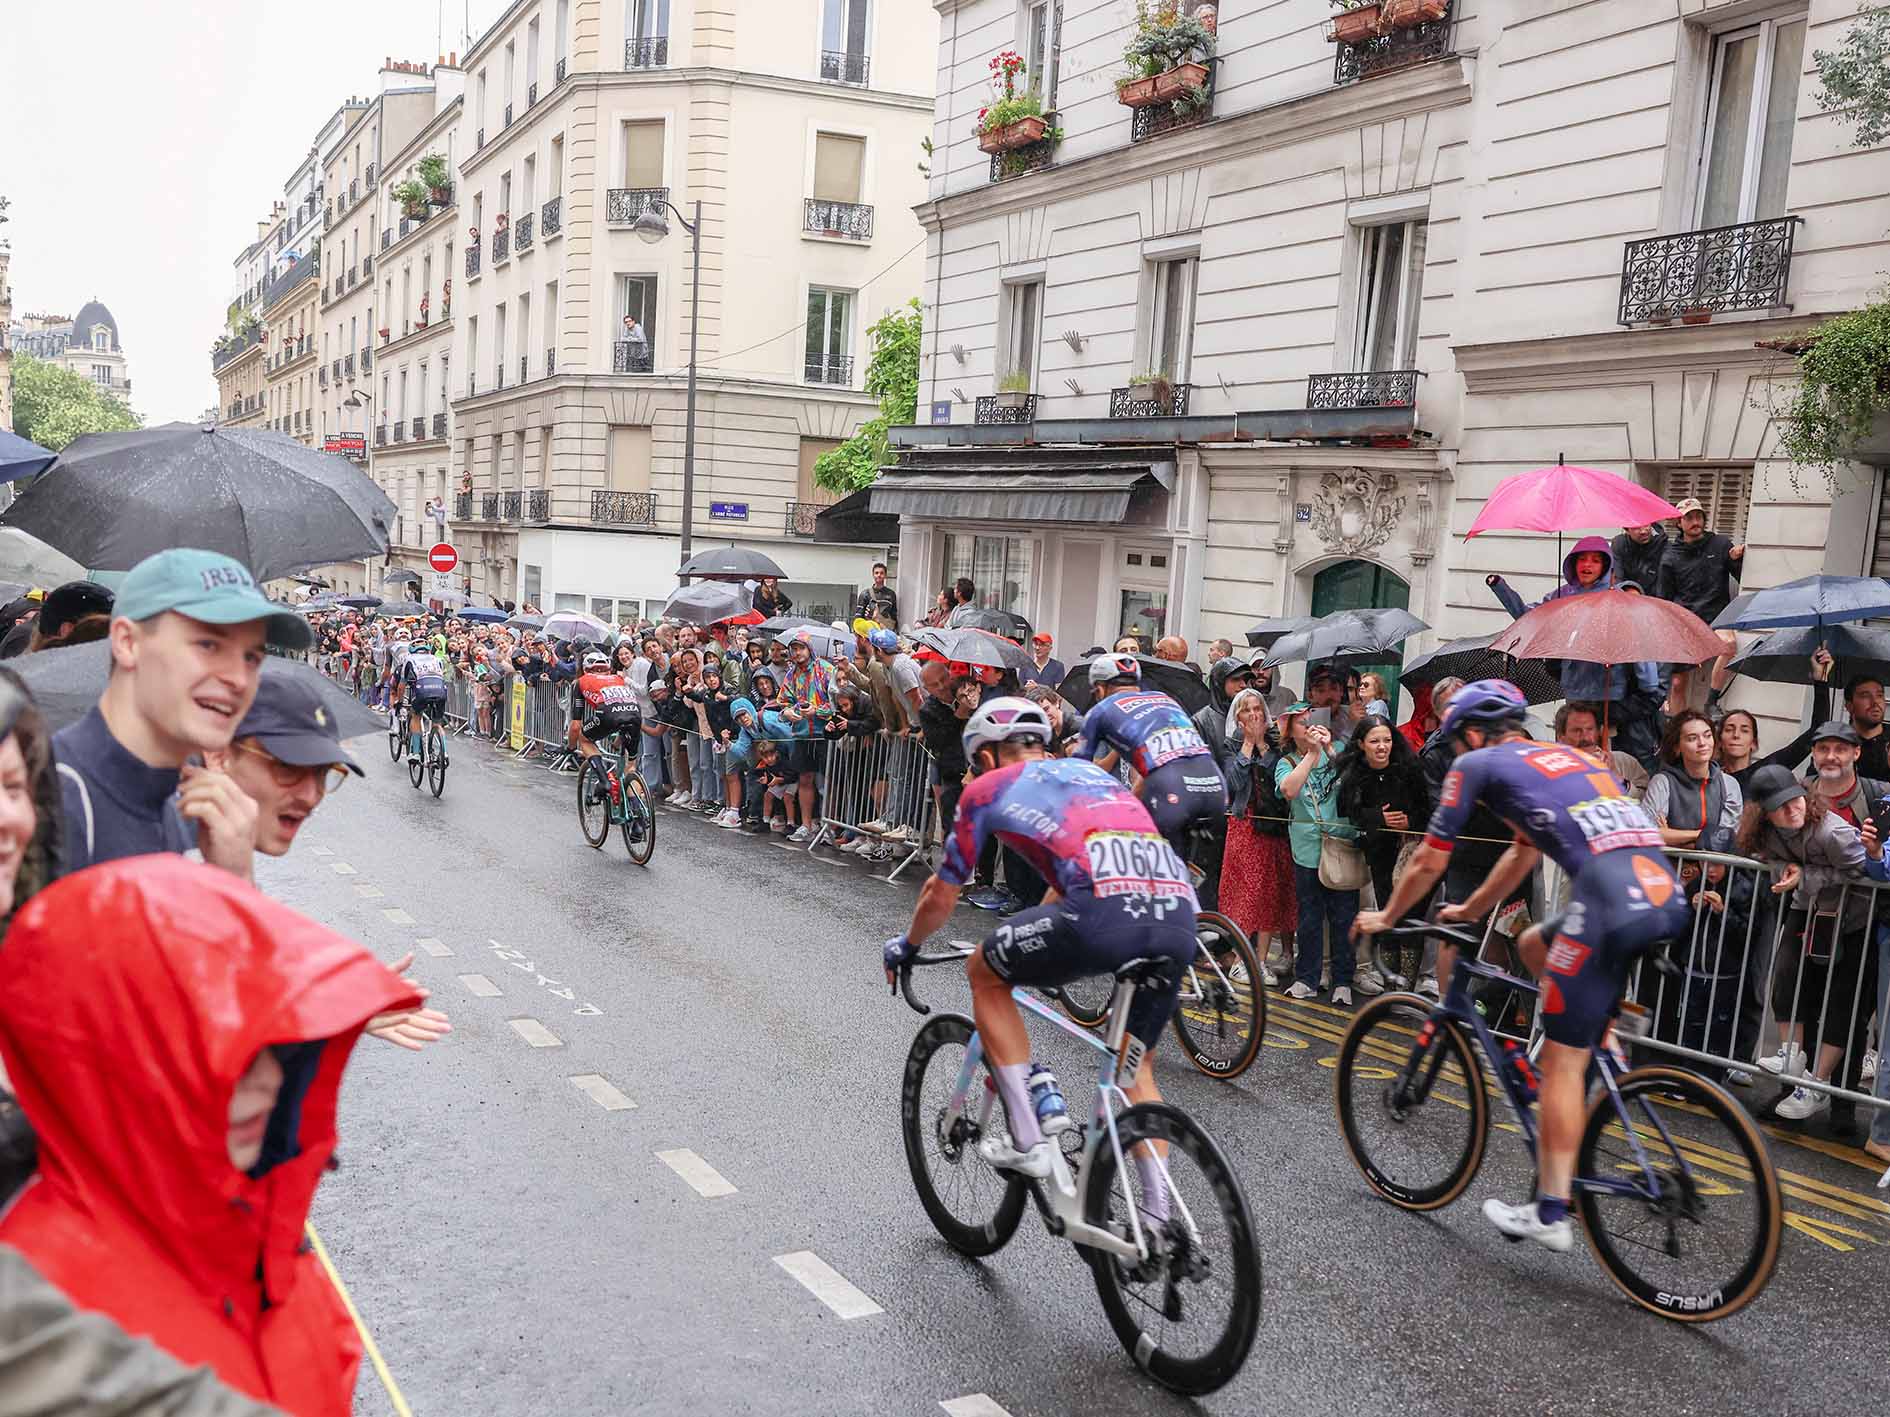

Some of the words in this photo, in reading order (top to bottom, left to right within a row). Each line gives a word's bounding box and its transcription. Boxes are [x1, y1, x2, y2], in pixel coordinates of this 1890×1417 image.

[611, 704, 639, 712] ARKEA
[1001, 801, 1061, 839] FACTOR
[1655, 1289, 1724, 1311] URSUS
